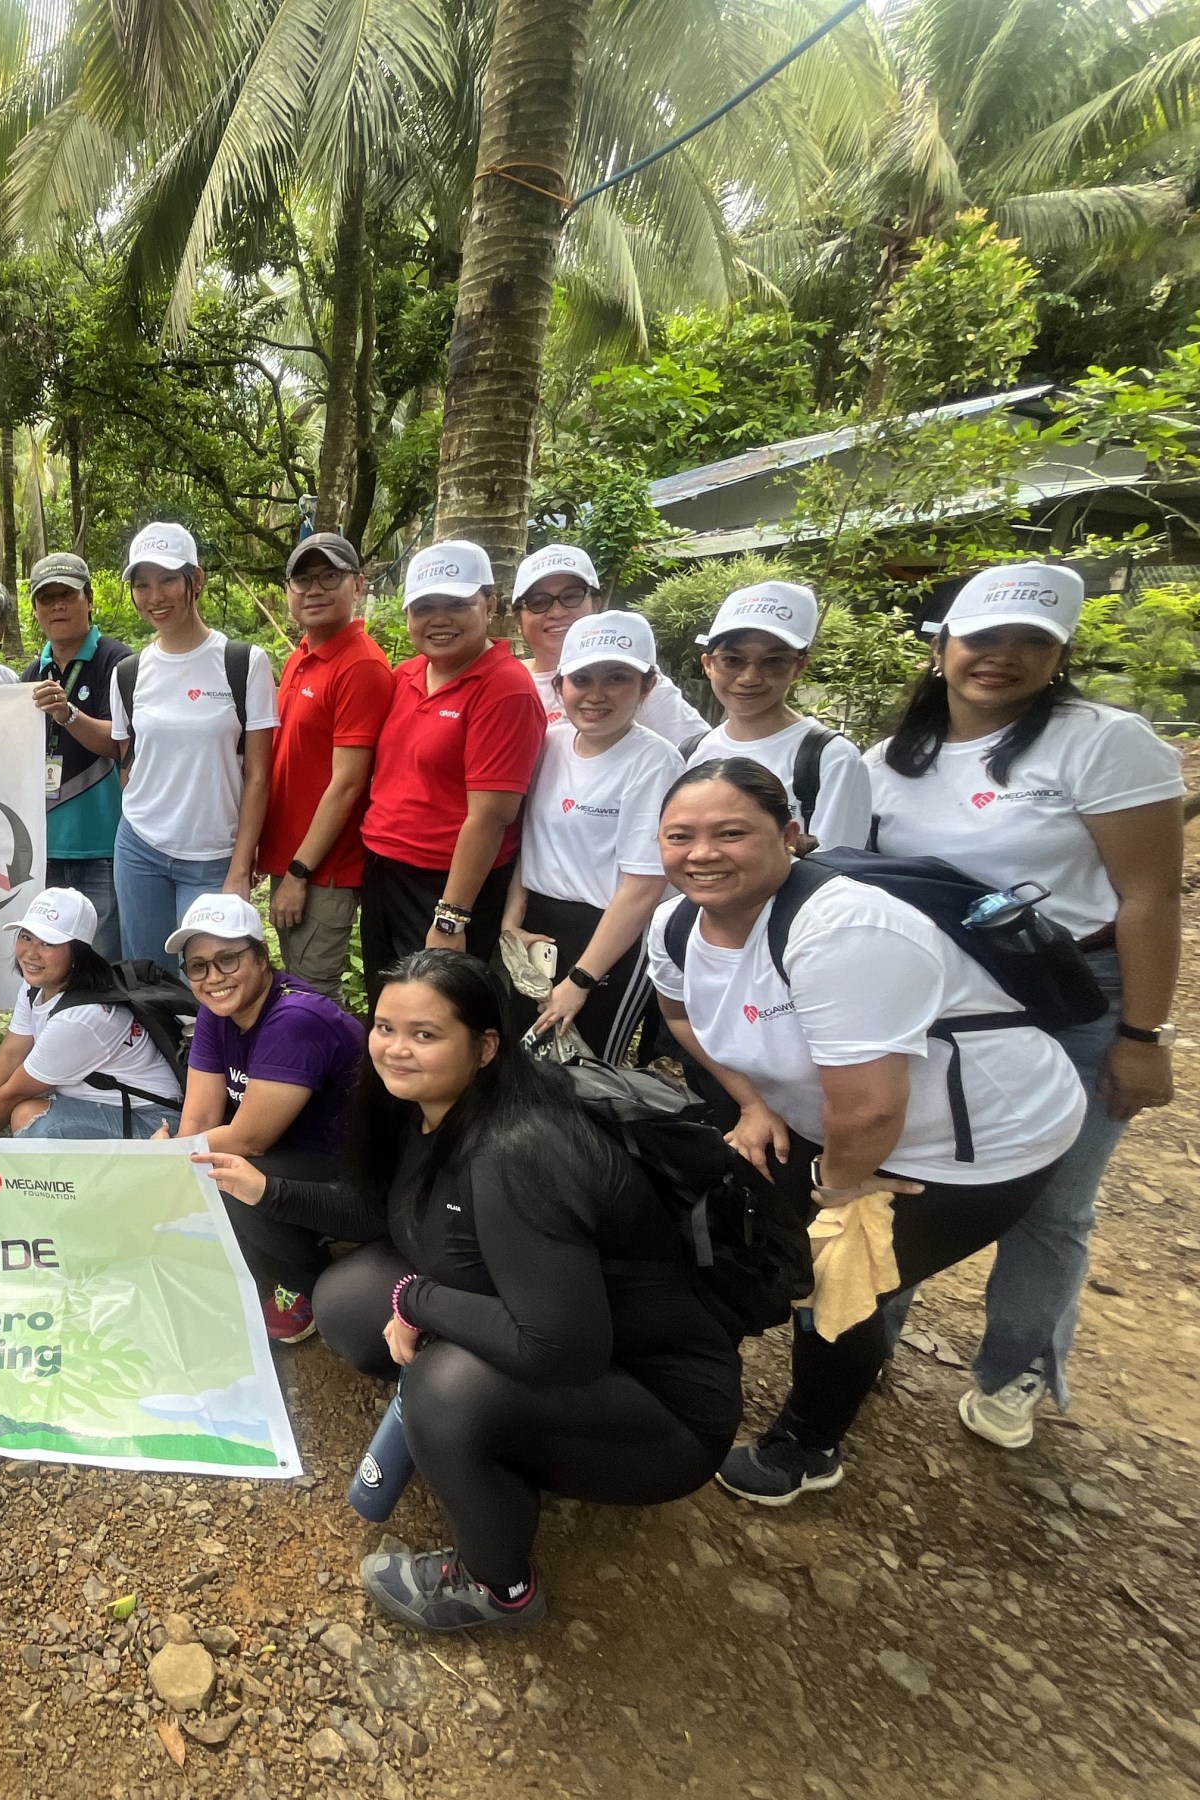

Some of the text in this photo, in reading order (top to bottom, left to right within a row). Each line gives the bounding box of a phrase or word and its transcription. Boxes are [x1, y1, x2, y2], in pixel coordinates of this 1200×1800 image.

[417, 569, 429, 582] NET
[983, 590, 1010, 604] NET
[733, 603, 754, 616] NET
[579, 637, 596, 650] NET
[997, 789, 1064, 801] MEGAWIDE
[5, 1179, 75, 1193] MEGAWIDE
[23, 1190, 76, 1200] FOUNDATION
